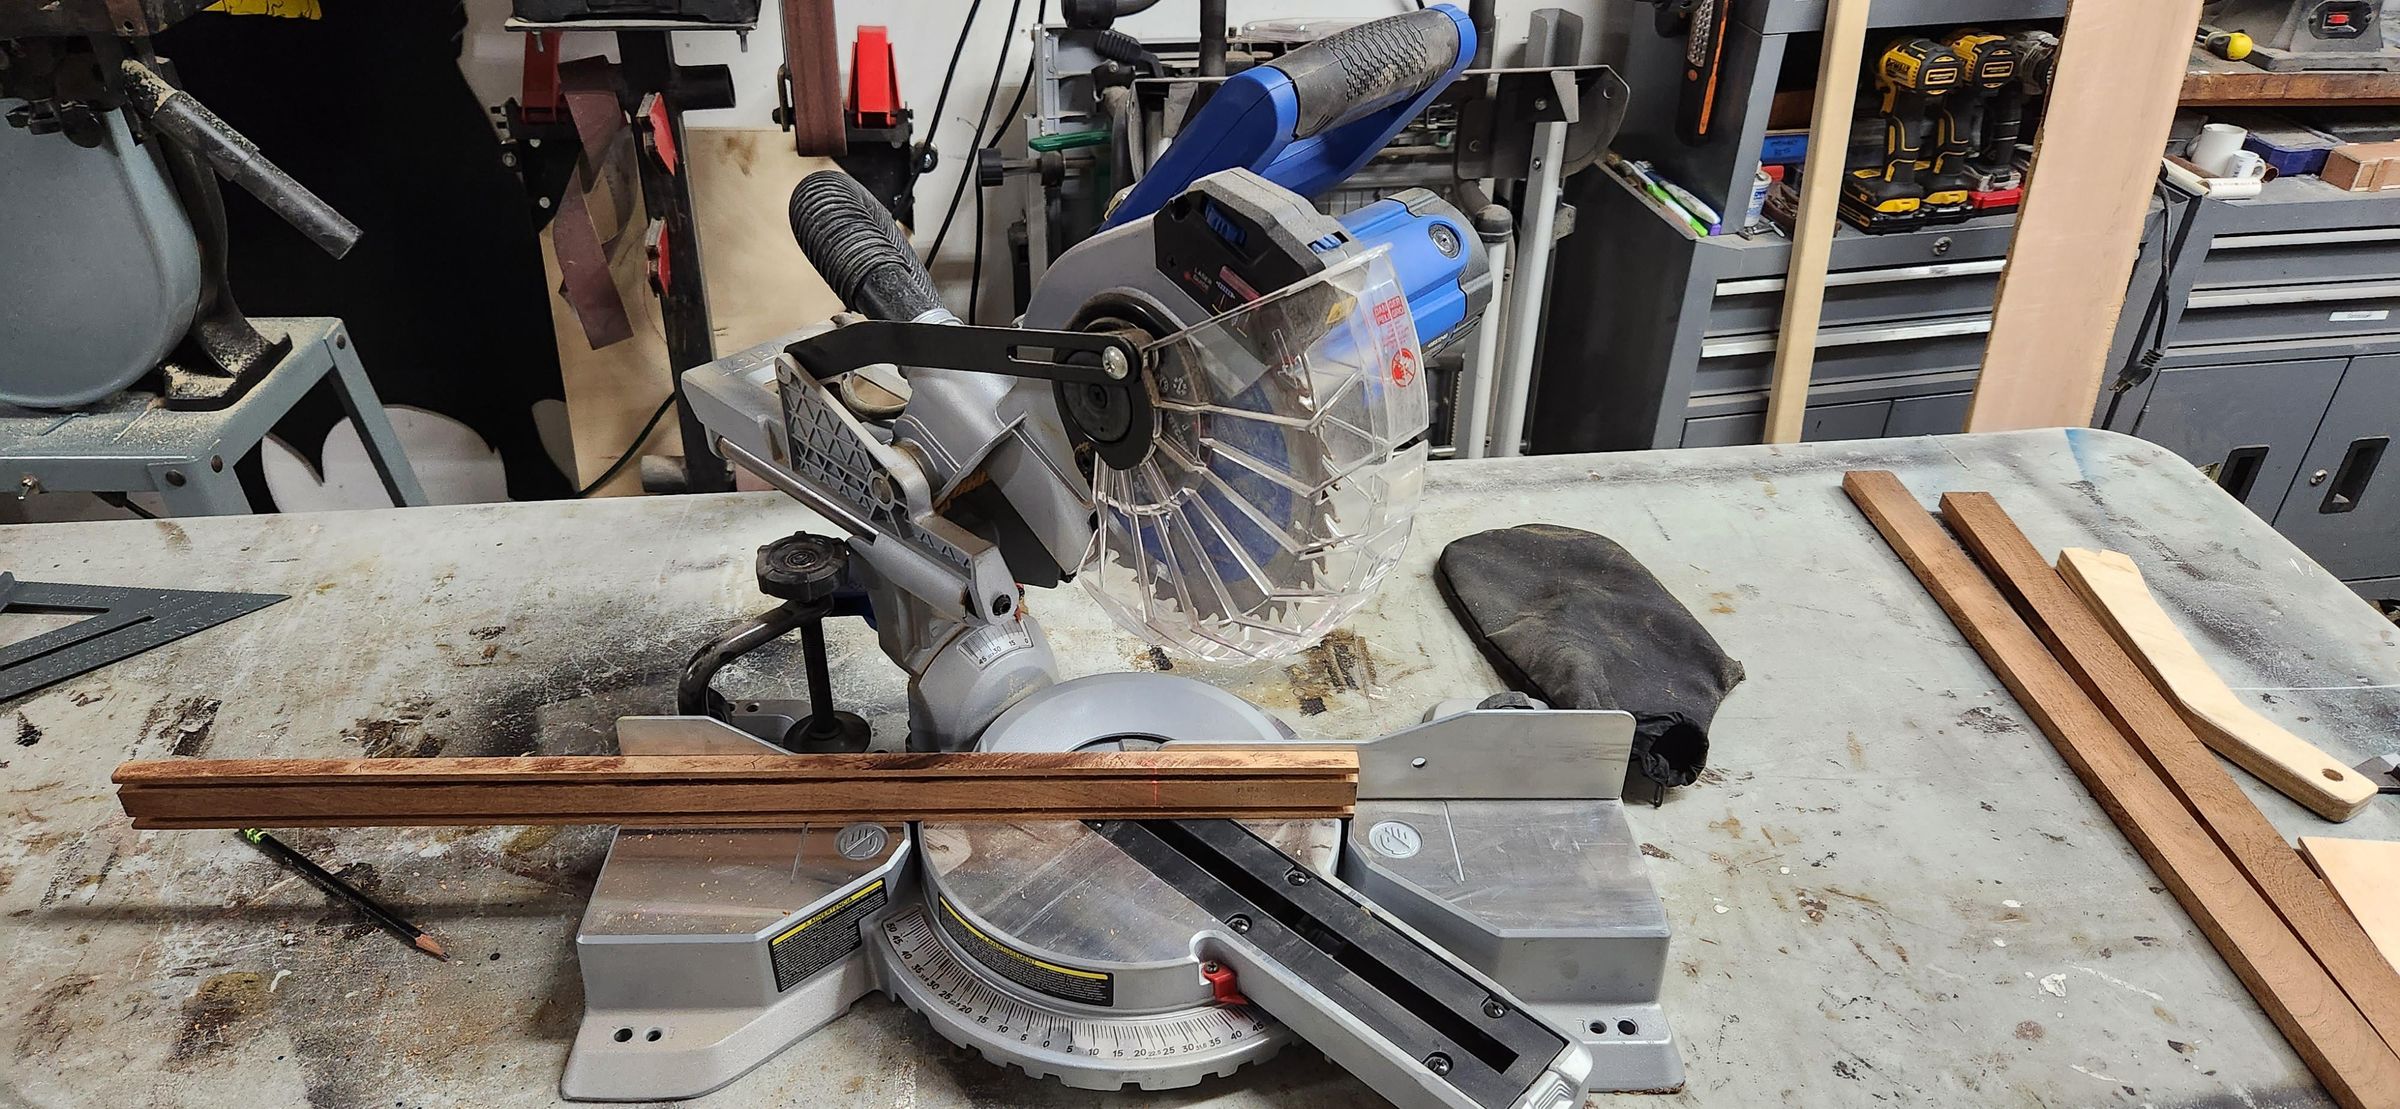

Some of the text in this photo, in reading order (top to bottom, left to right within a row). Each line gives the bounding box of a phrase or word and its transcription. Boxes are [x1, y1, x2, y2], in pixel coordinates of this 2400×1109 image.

[979, 656, 987, 664] 45
[993, 646, 1001, 655] 30
[886, 922, 898, 933] 50
[892, 934, 904, 945] 45
[901, 950, 913, 960] 40
[911, 963, 924, 974] 35
[926, 980, 940, 990] 30
[938, 990, 953, 1000] 25
[958, 1004, 973, 1014] 20
[976, 1014, 989, 1024] 15
[997, 1024, 1009, 1033] 10
[1020, 1033, 1028, 1041] 5
[1042, 1040, 1050, 1048] 0
[1066, 1045, 1074, 1053] 5
[1088, 1048, 1100, 1056] 10
[1112, 1049, 1124, 1057] 15
[1134, 1049, 1147, 1057] 20
[1163, 1047, 1176, 1055] 25
[1182, 1043, 1194, 1053] 30
[1209, 1037, 1222, 1047] 35
[1230, 1030, 1242, 1040] 40
[1252, 1022, 1264, 1032] 45
